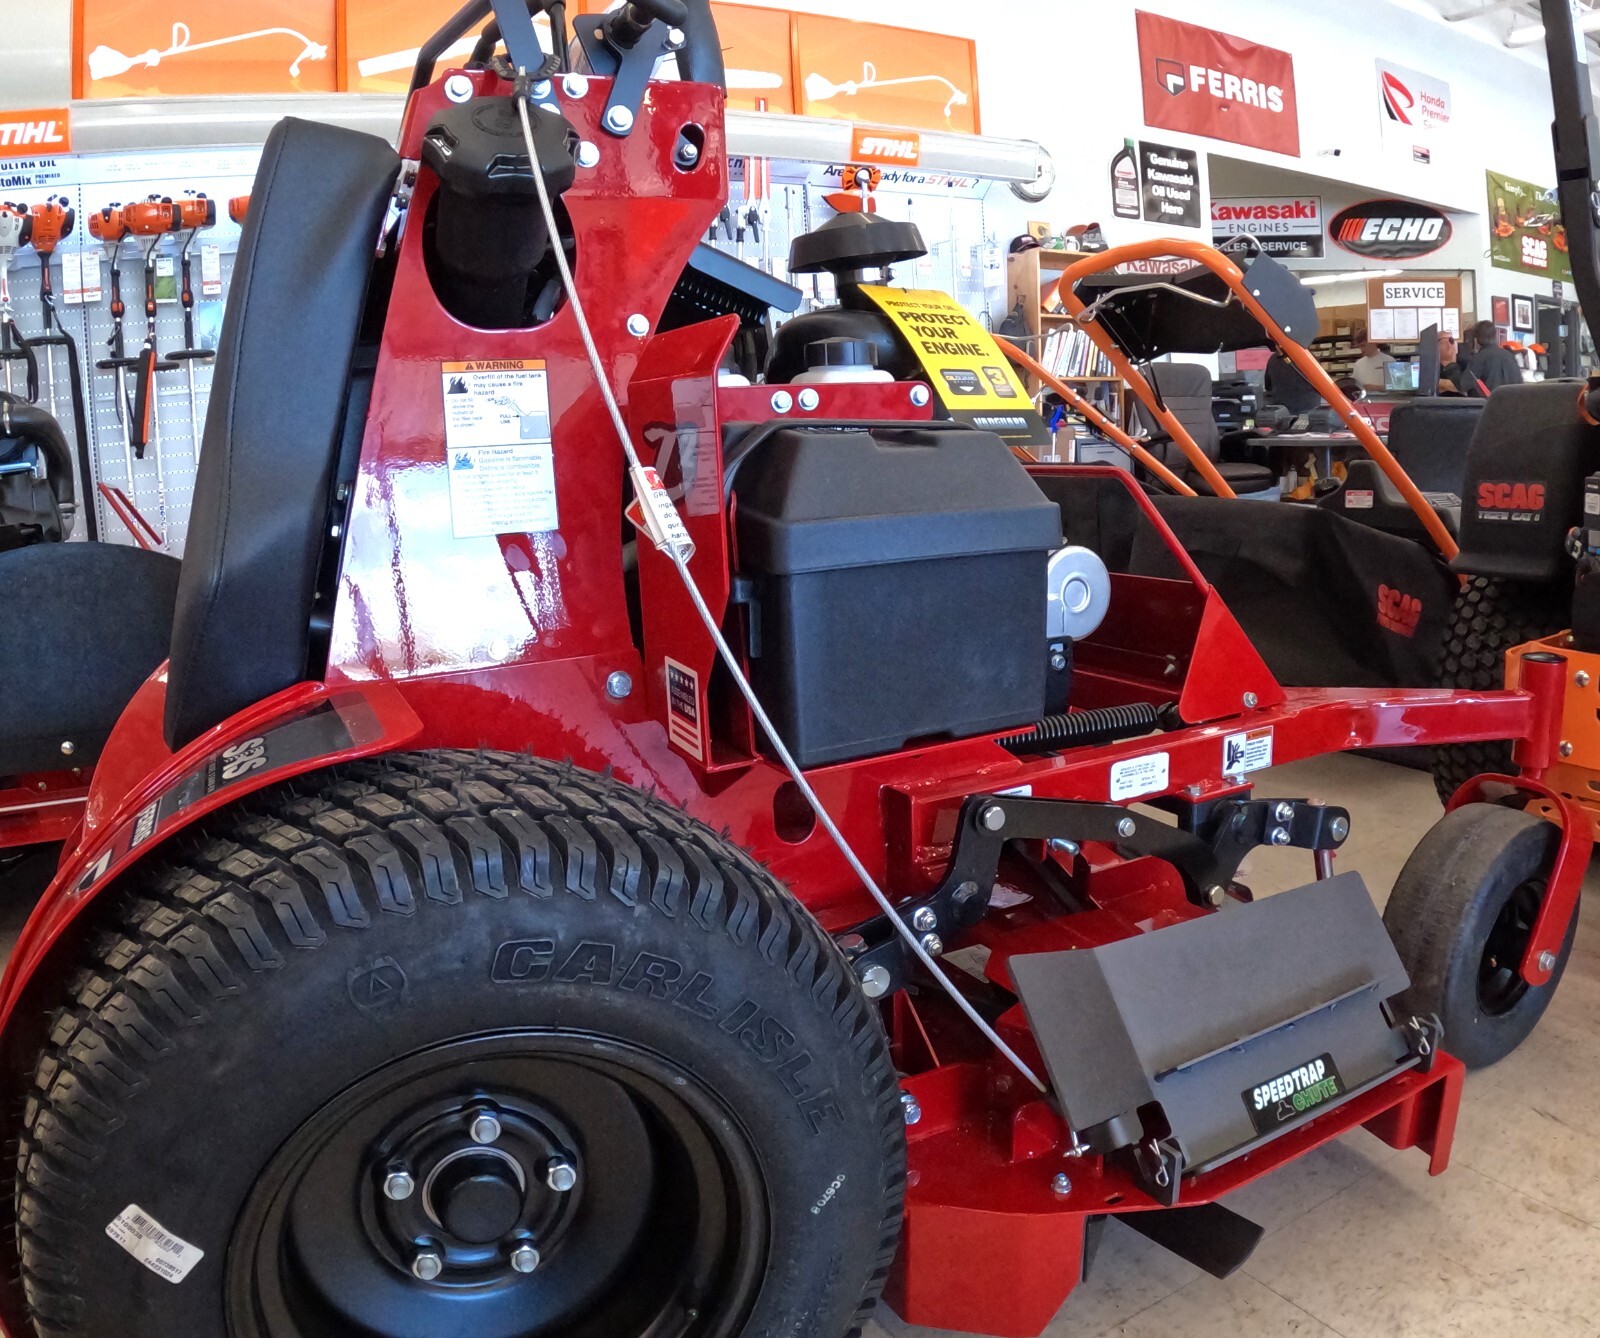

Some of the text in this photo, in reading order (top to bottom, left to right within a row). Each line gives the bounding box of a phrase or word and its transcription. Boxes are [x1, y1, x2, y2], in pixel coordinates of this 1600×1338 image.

[1189, 64, 1284, 113] FERRIS
[1420, 91, 1445, 109] Honda
[1422, 105, 1450, 123] Premier
[859, 137, 917, 159] STIHL
[1149, 153, 1189, 170] Genuine
[0, 175, 32, 187] toMix
[823, 165, 844, 177] Are
[902, 172, 918, 183] for
[926, 175, 969, 188] STIHL
[1147, 168, 1194, 186] Kawasaki
[1151, 184, 1191, 201] Oil Used
[1160, 202, 1184, 215] Here
[1228, 222, 1290, 233] ENGINES
[1360, 217, 1444, 241] ECHO
[1261, 241, 1308, 251] SERVICE
[1521, 235, 1548, 260] SCAG
[1385, 287, 1445, 300] SERVICE
[885, 300, 920, 309] PROTECT
[922, 302, 942, 310] YOUR
[897, 310, 971, 326] PROTECT
[910, 325, 959, 340] YOUR
[921, 341, 990, 357] ENGINE.
[475, 360, 524, 370] WARNING
[987, 368, 1007, 385] 3
[1477, 482, 1546, 511] SCAG
[490, 938, 846, 1137] CARLISLE
[1253, 1058, 1326, 1111] SPEEDTRAP
[1292, 1075, 1339, 1111] CHUTE
